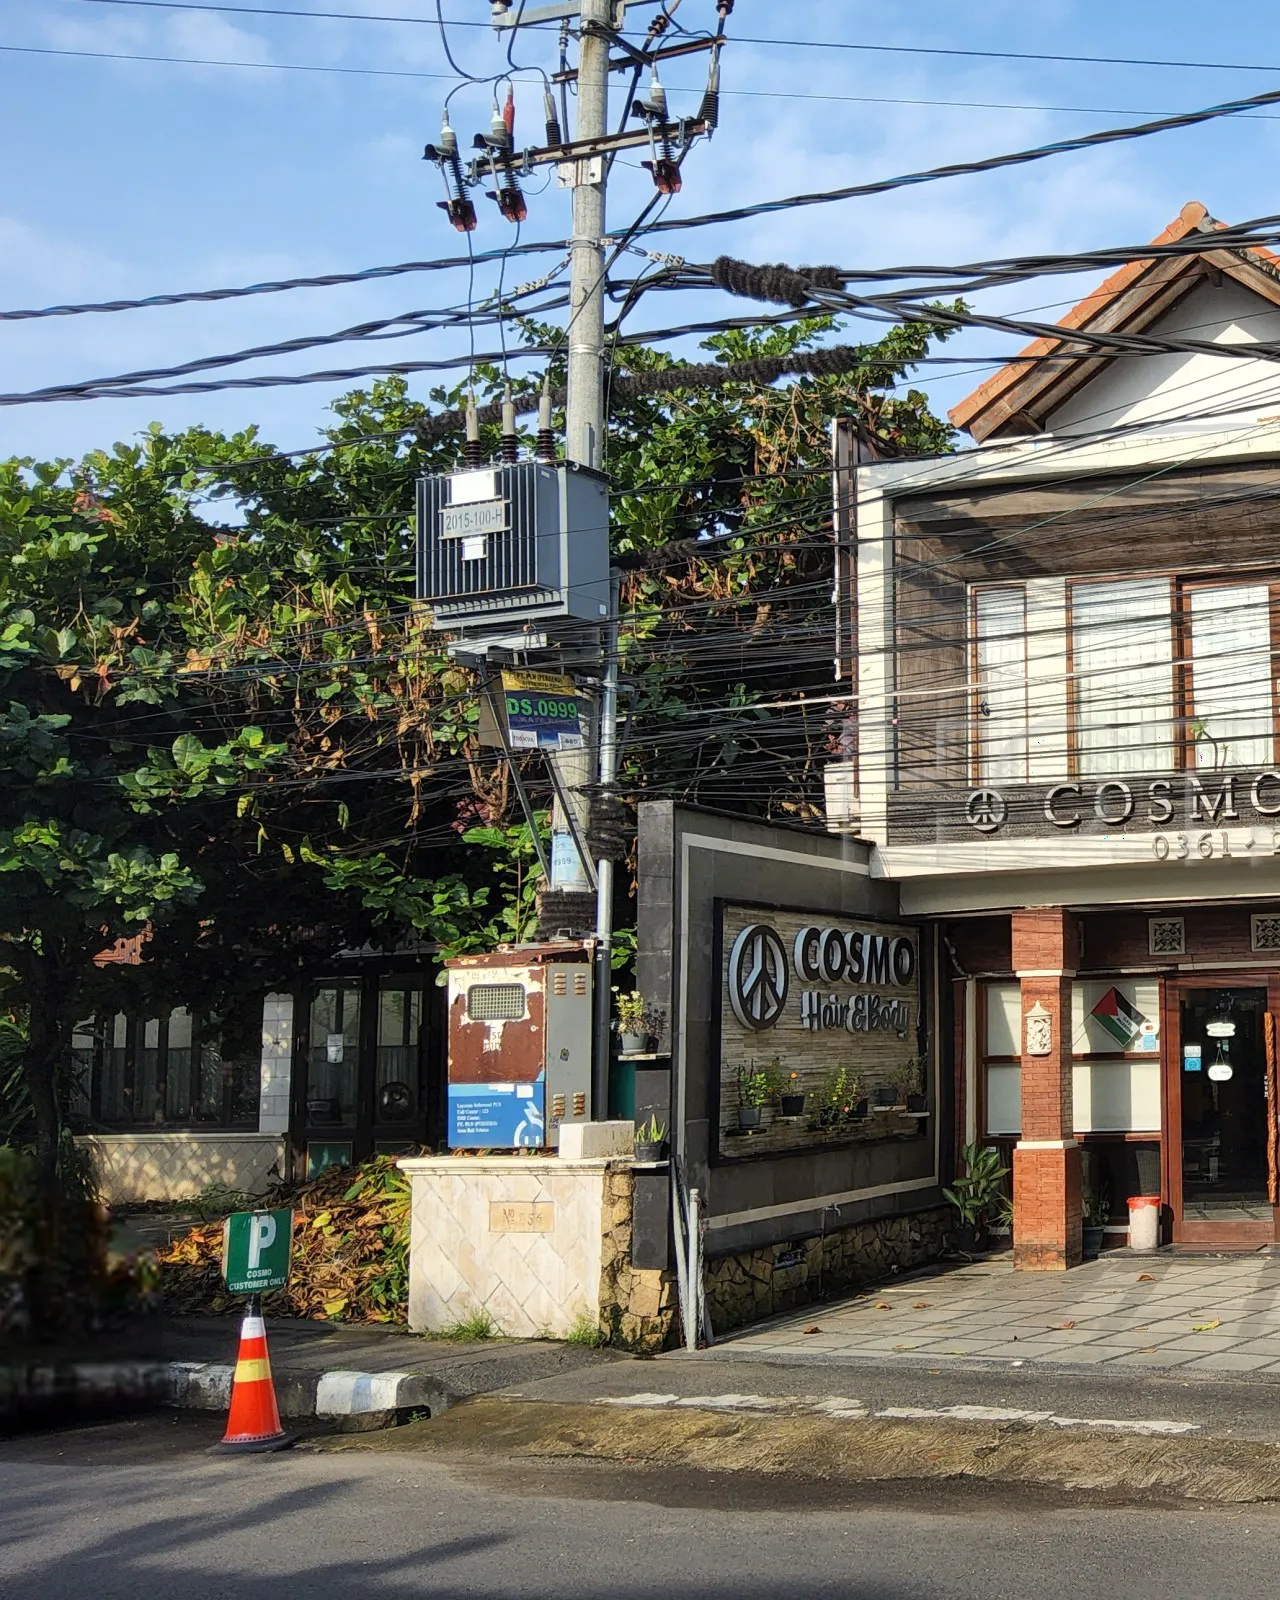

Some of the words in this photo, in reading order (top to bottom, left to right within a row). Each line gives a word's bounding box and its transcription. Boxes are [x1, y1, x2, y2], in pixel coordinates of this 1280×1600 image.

[446, 508, 502, 531] 2015-100-H
[506, 697, 577, 719] DS.0999
[1152, 829, 1233, 860] 0361
[793, 926, 915, 986] COSMO
[247, 1215, 277, 1269] P
[228, 1279, 269, 1291] CUSTOMER
[269, 1276, 286, 1286] ONLY
[246, 1268, 272, 1279] COSMO
